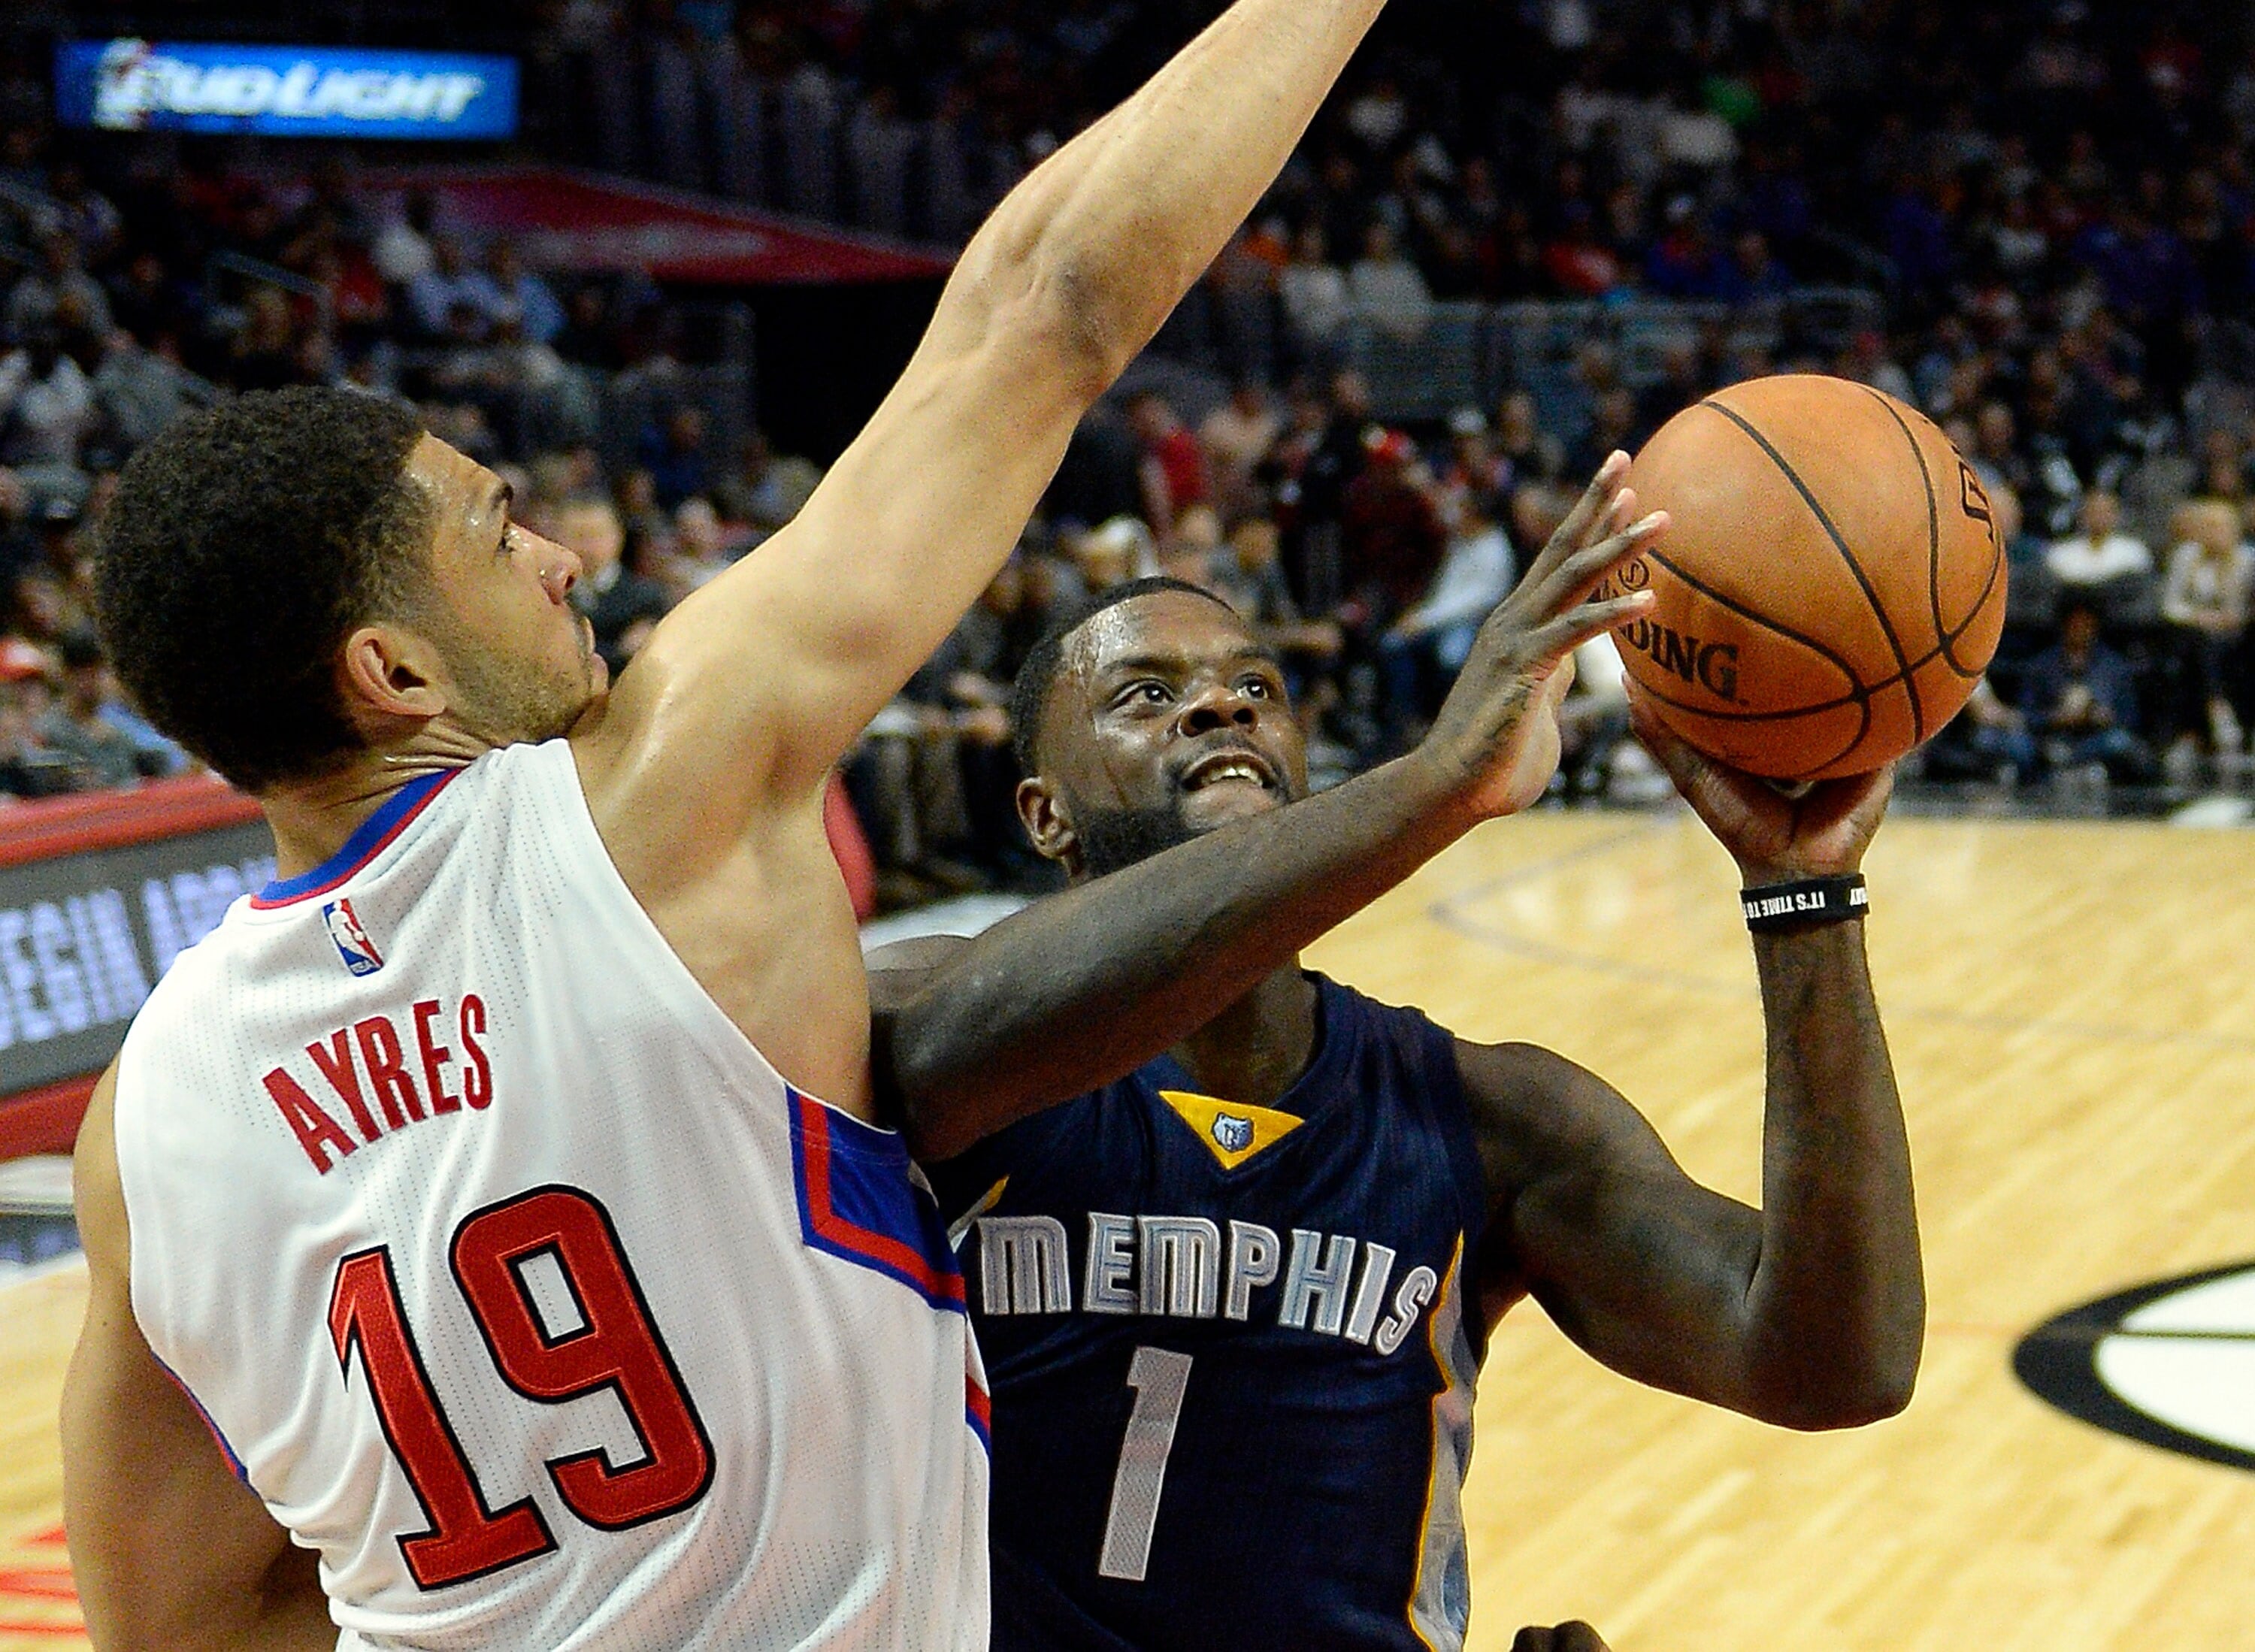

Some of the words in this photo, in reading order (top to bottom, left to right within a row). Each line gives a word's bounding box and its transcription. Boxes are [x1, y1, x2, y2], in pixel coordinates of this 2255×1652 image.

[274, 60, 486, 123] LIGHT
[1747, 900, 1761, 918] TO
[1760, 895, 1795, 916] TIME
[1796, 891, 1826, 911] IT'S
[262, 994, 493, 1175] AYRES
[978, 1212, 1438, 1356] MEMPHIS
[327, 1182, 716, 1592] 19
[1098, 1346, 1194, 1582] 1
